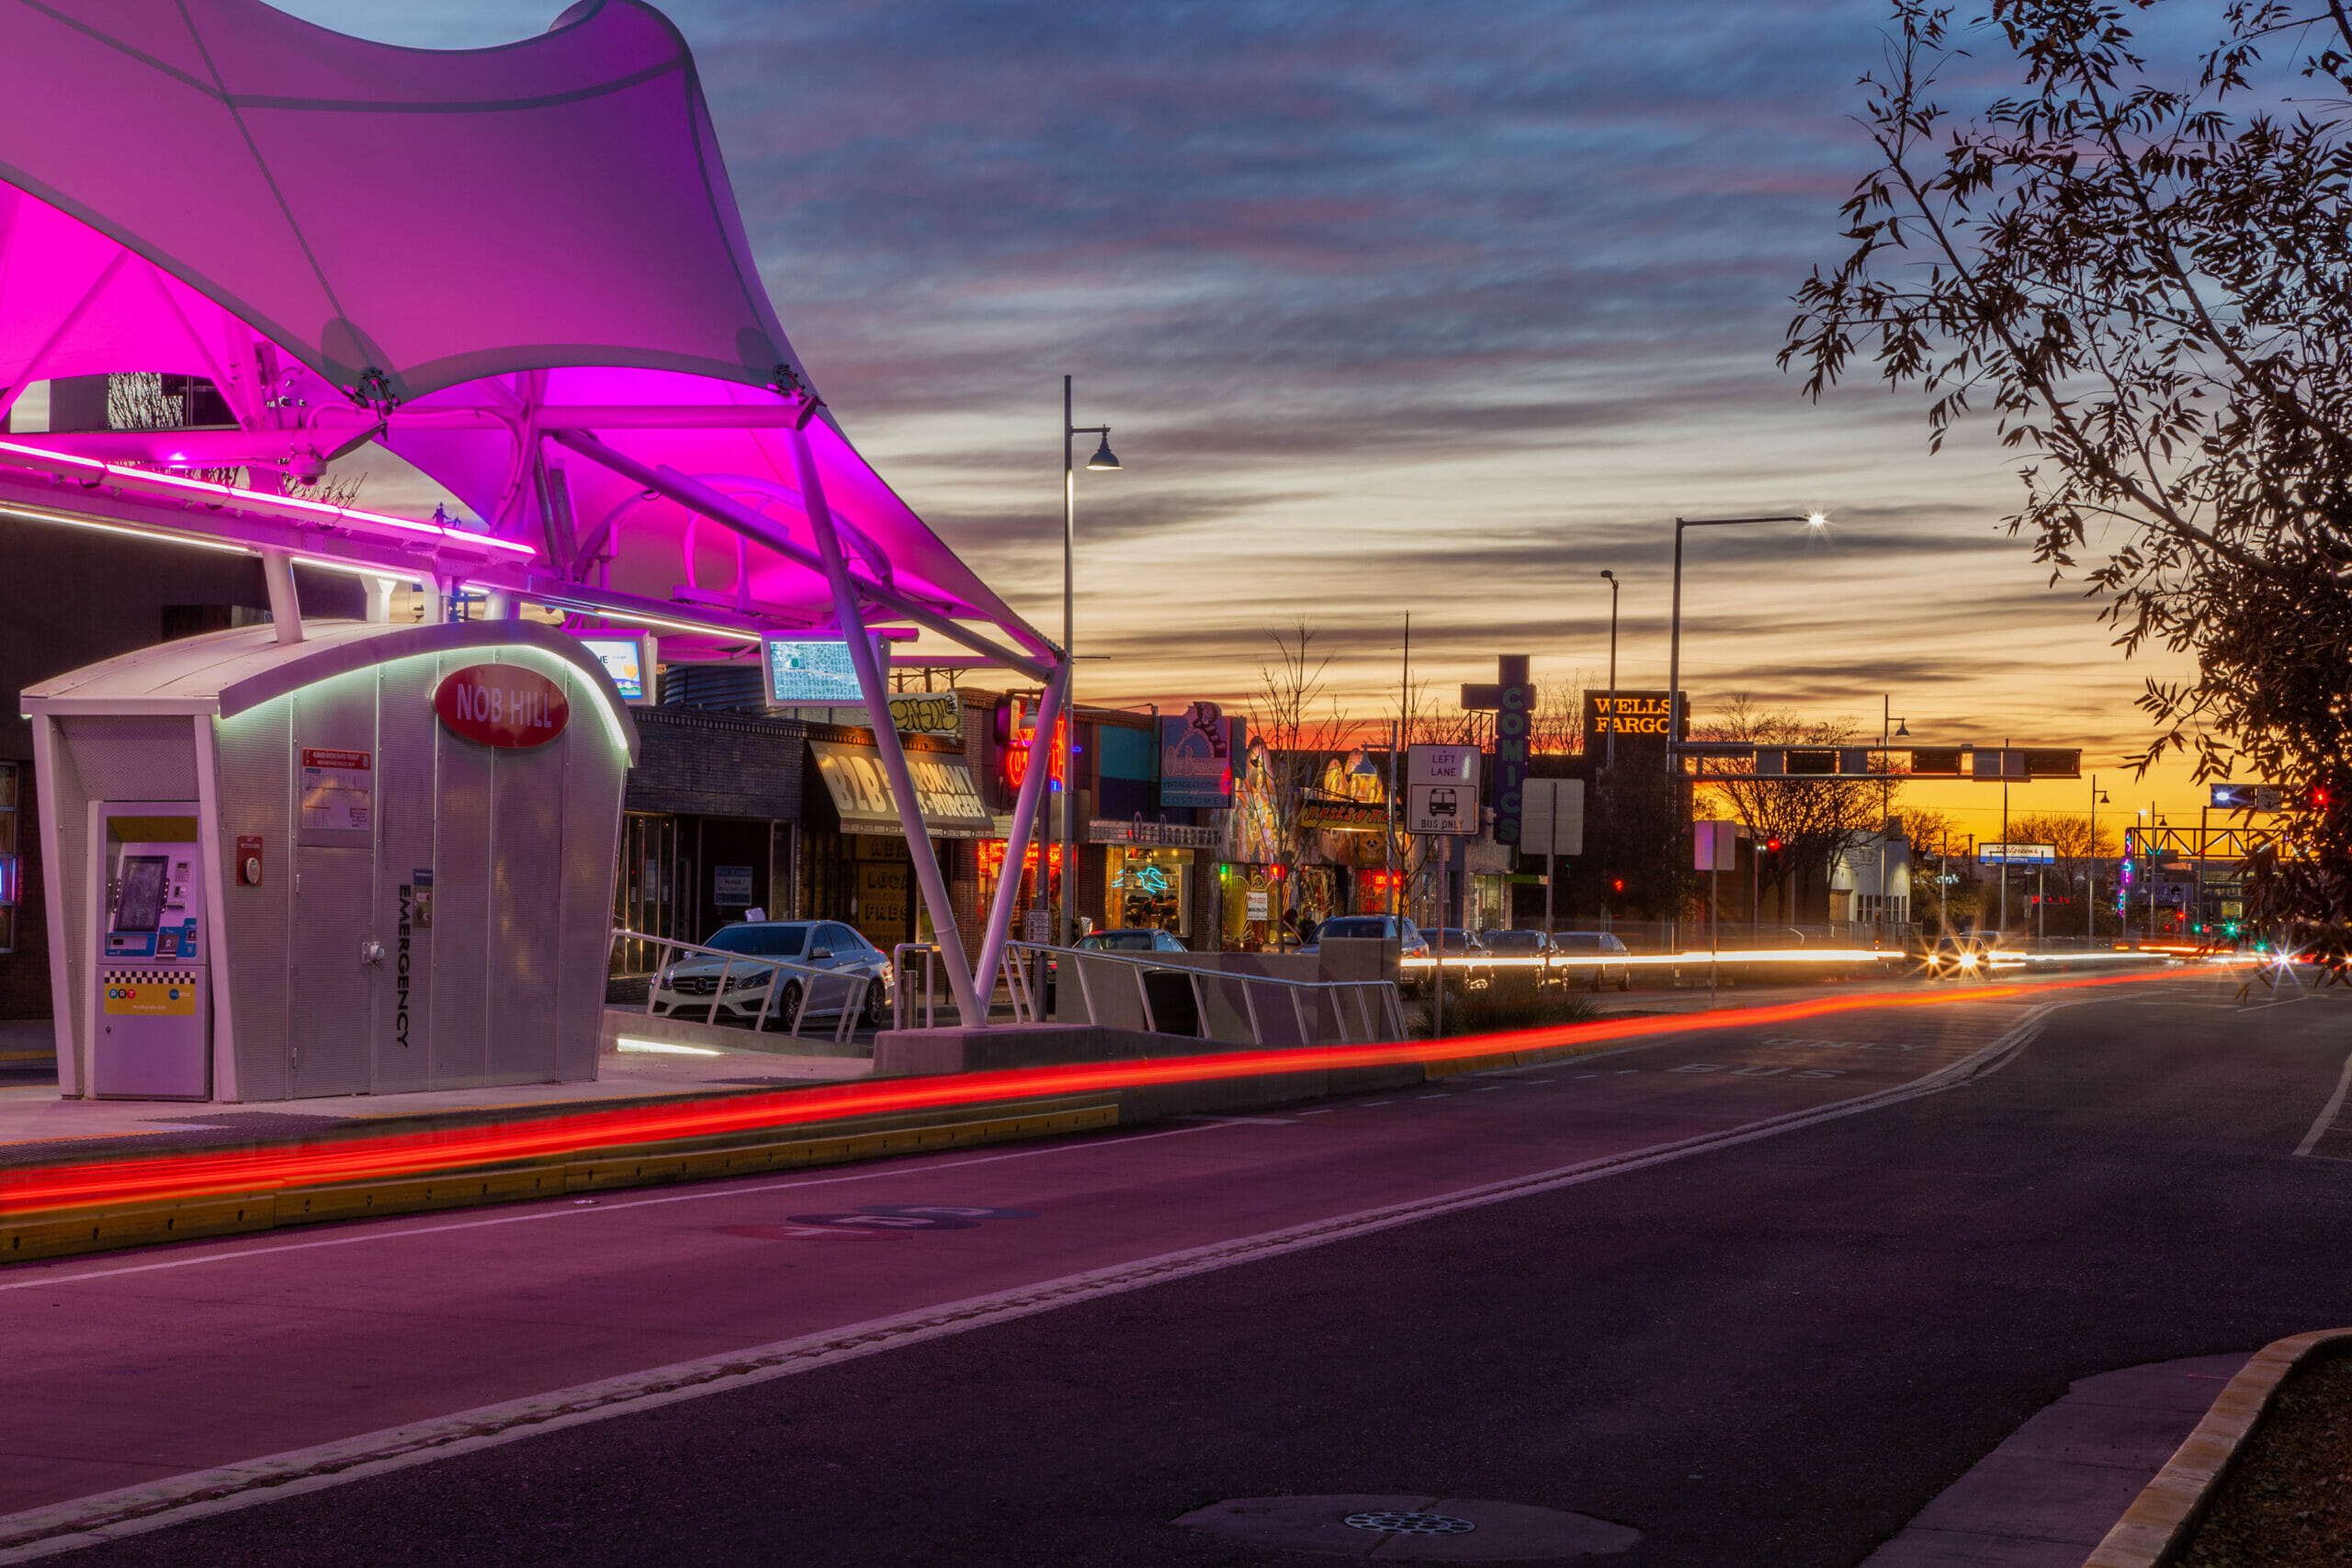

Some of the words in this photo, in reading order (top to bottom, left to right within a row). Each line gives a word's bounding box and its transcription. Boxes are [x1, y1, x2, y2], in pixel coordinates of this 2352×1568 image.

[457, 683, 503, 722] NOB
[511, 690, 552, 728] HILL
[1594, 698, 1670, 715] WELLS
[1432, 755, 1455, 763] LEFT
[1499, 688, 1523, 840] COMICS
[1430, 768, 1456, 776] LANE
[817, 752, 887, 813] B2B
[1163, 795, 1227, 805] COSTUMES
[1421, 819, 1438, 829] BUS
[1442, 819, 1464, 829] ONLY
[396, 885, 411, 1049] EMERGENCY
[110, 990, 135, 998] ART
[1761, 1038, 1931, 1052] ONLY
[1663, 1063, 1846, 1079] BUS
